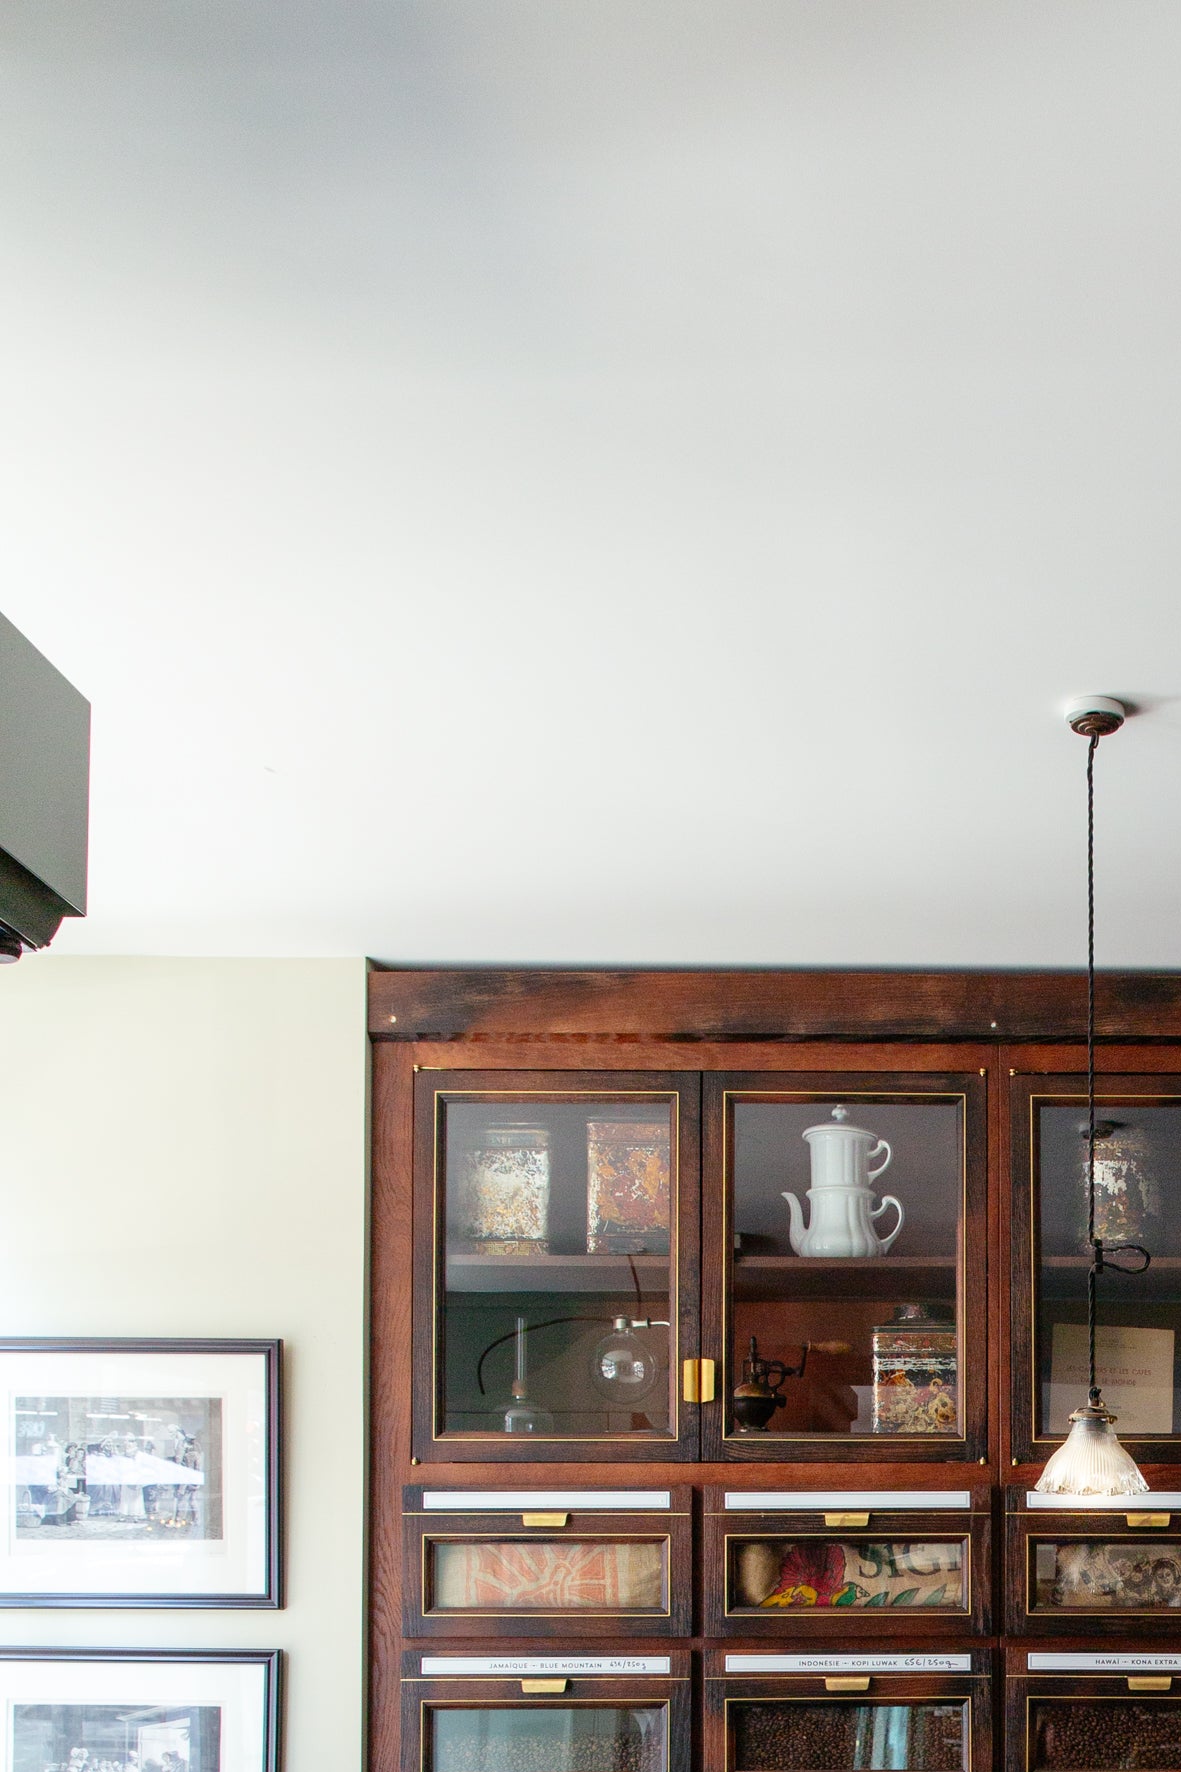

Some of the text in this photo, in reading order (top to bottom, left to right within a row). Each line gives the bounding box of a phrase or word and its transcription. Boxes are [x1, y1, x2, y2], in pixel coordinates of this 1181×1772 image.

[798, 1659, 840, 1667] INDONÉSIE
[851, 1659, 870, 1667] KOPI
[872, 1659, 898, 1667] LUWAK
